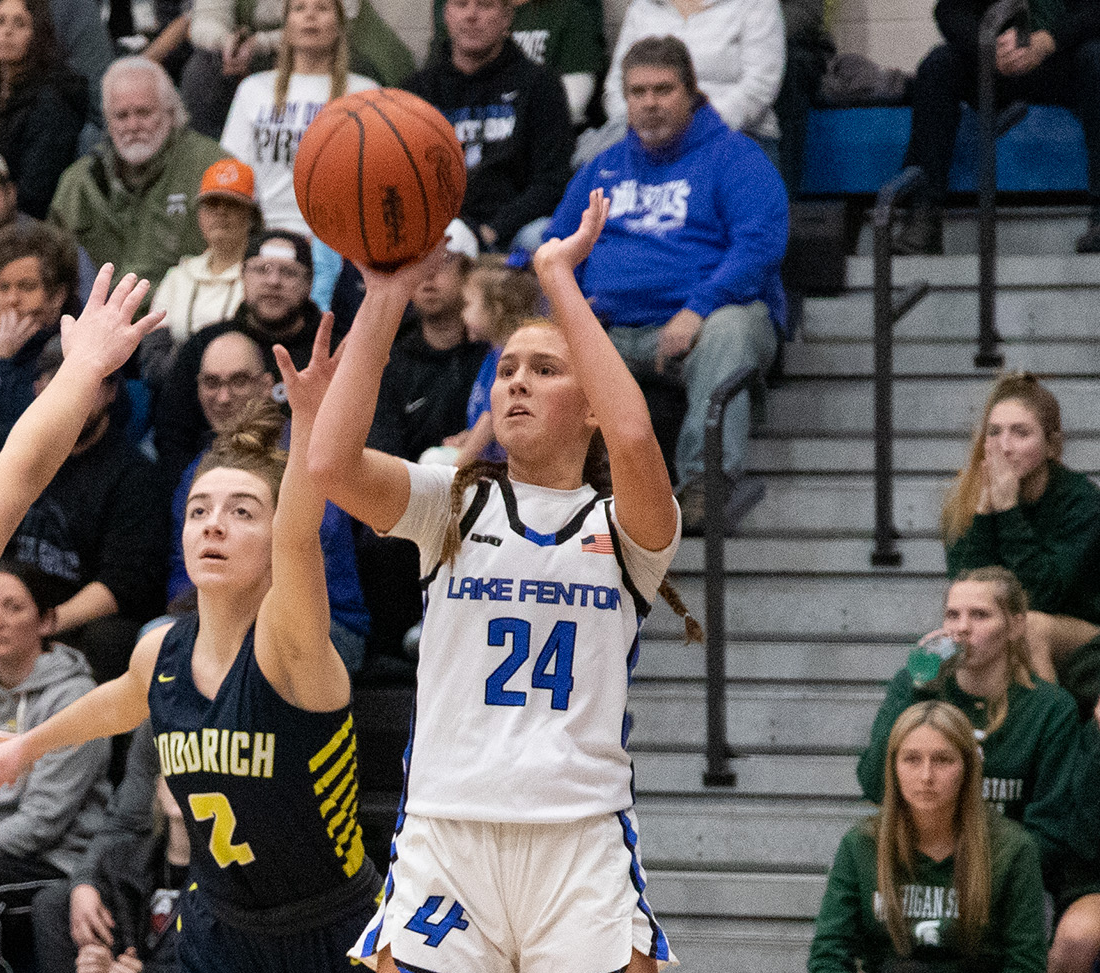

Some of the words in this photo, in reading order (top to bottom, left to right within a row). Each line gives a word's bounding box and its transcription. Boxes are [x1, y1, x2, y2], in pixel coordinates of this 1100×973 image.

[447, 576, 514, 601] LAKE
[484, 616, 577, 711] 24
[154, 728, 276, 778] OODRICH
[188, 792, 256, 869] 2
